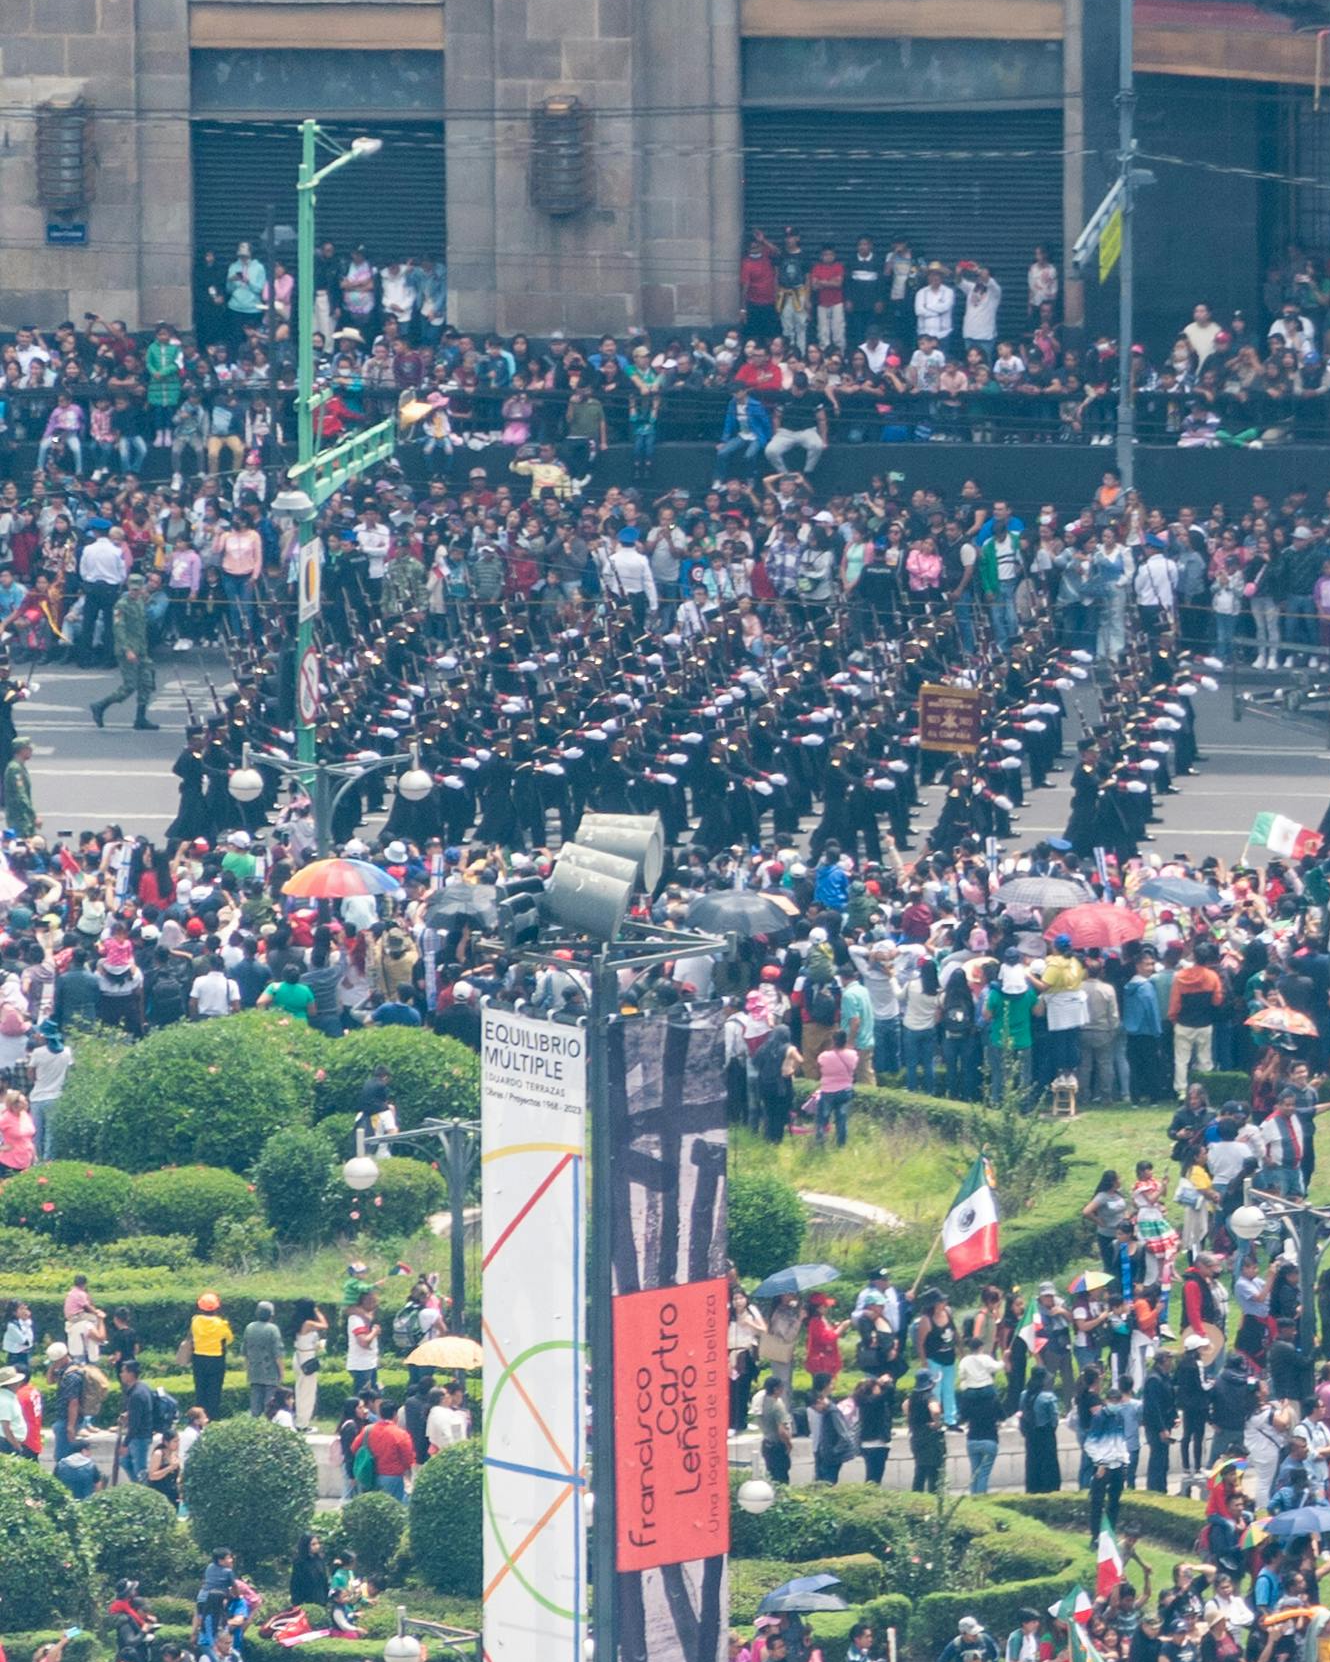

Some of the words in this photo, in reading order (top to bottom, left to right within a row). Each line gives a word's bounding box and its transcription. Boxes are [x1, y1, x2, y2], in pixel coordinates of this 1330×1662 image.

[485, 1021, 581, 1058] EQUILIBRIO
[485, 1045, 563, 1081] MÚLTIPLE
[526, 1081, 565, 1097] TERRAZAS
[652, 1302, 679, 1435] Castro
[675, 1365, 701, 1496] Leñero
